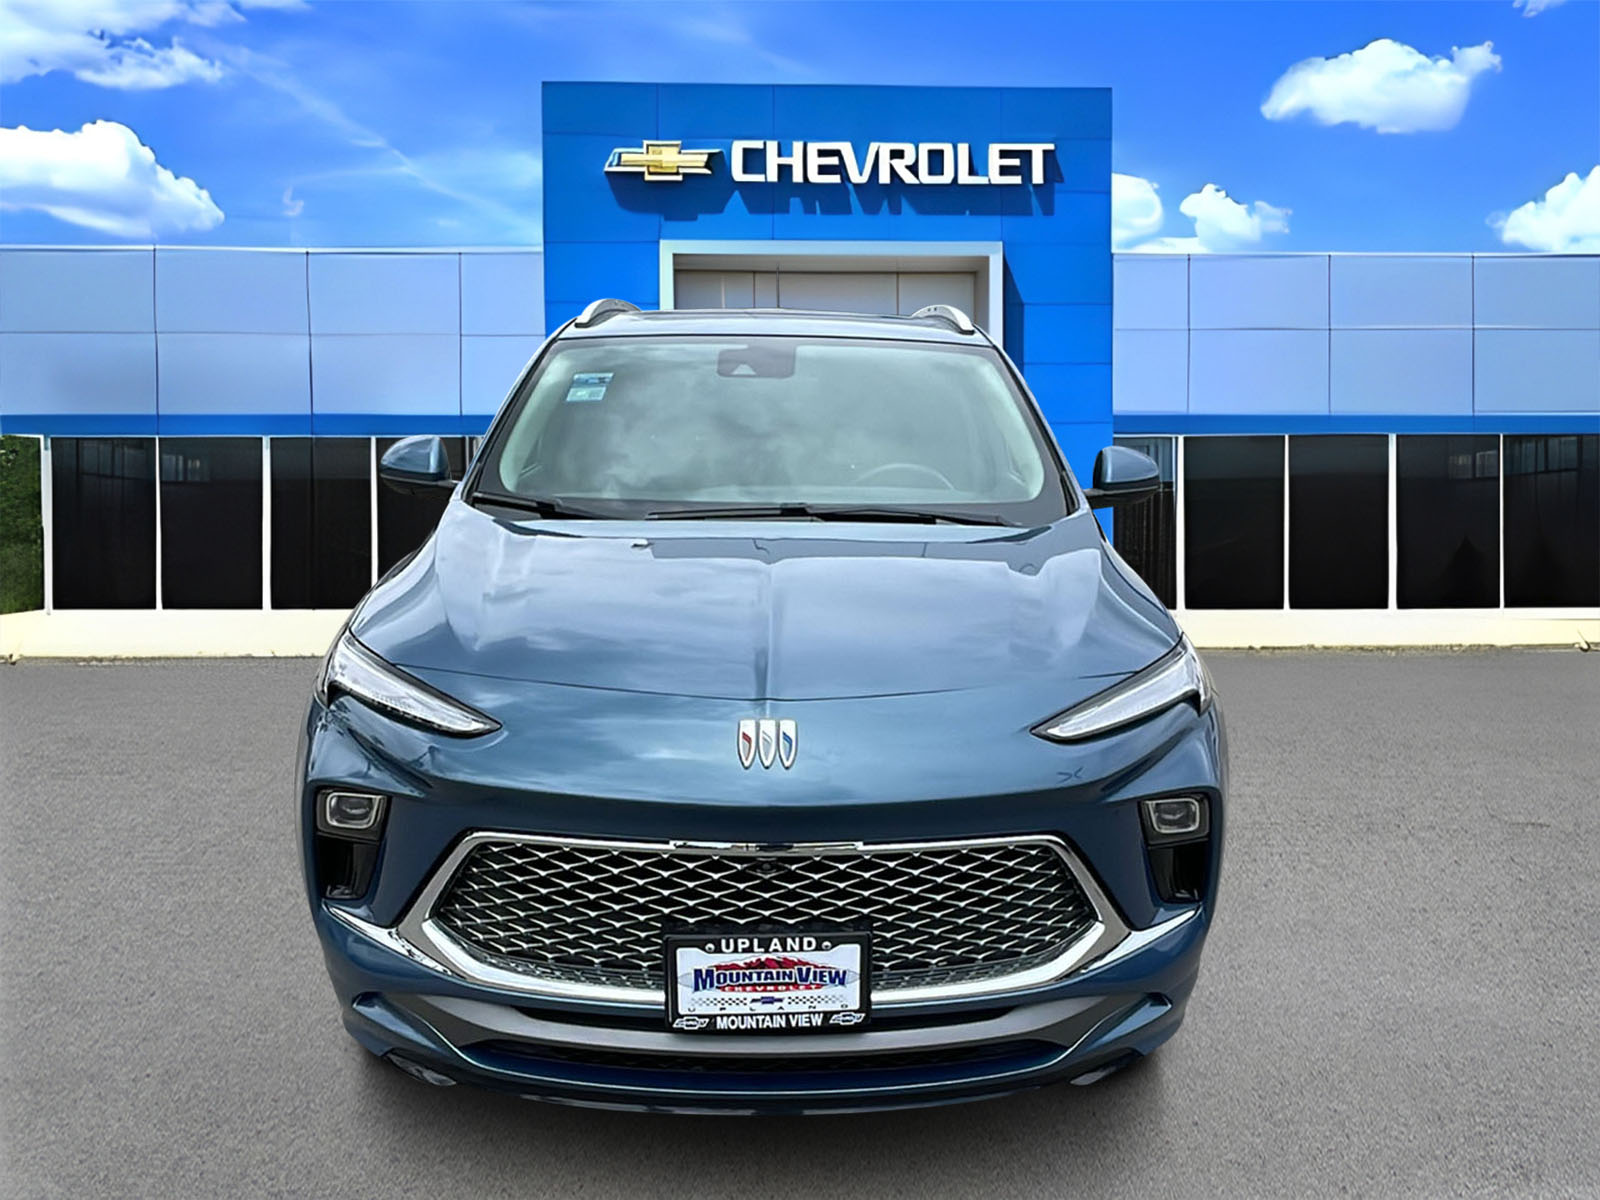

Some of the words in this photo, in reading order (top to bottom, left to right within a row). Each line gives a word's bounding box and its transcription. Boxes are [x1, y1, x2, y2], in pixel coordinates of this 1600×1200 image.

[731, 140, 1056, 185] CHEVROLET
[720, 937, 817, 954] UPLAND
[724, 984, 817, 993] CHEVROLET
[716, 1015, 787, 1030] MOUNTAIN
[788, 1013, 824, 1028] VIEW
